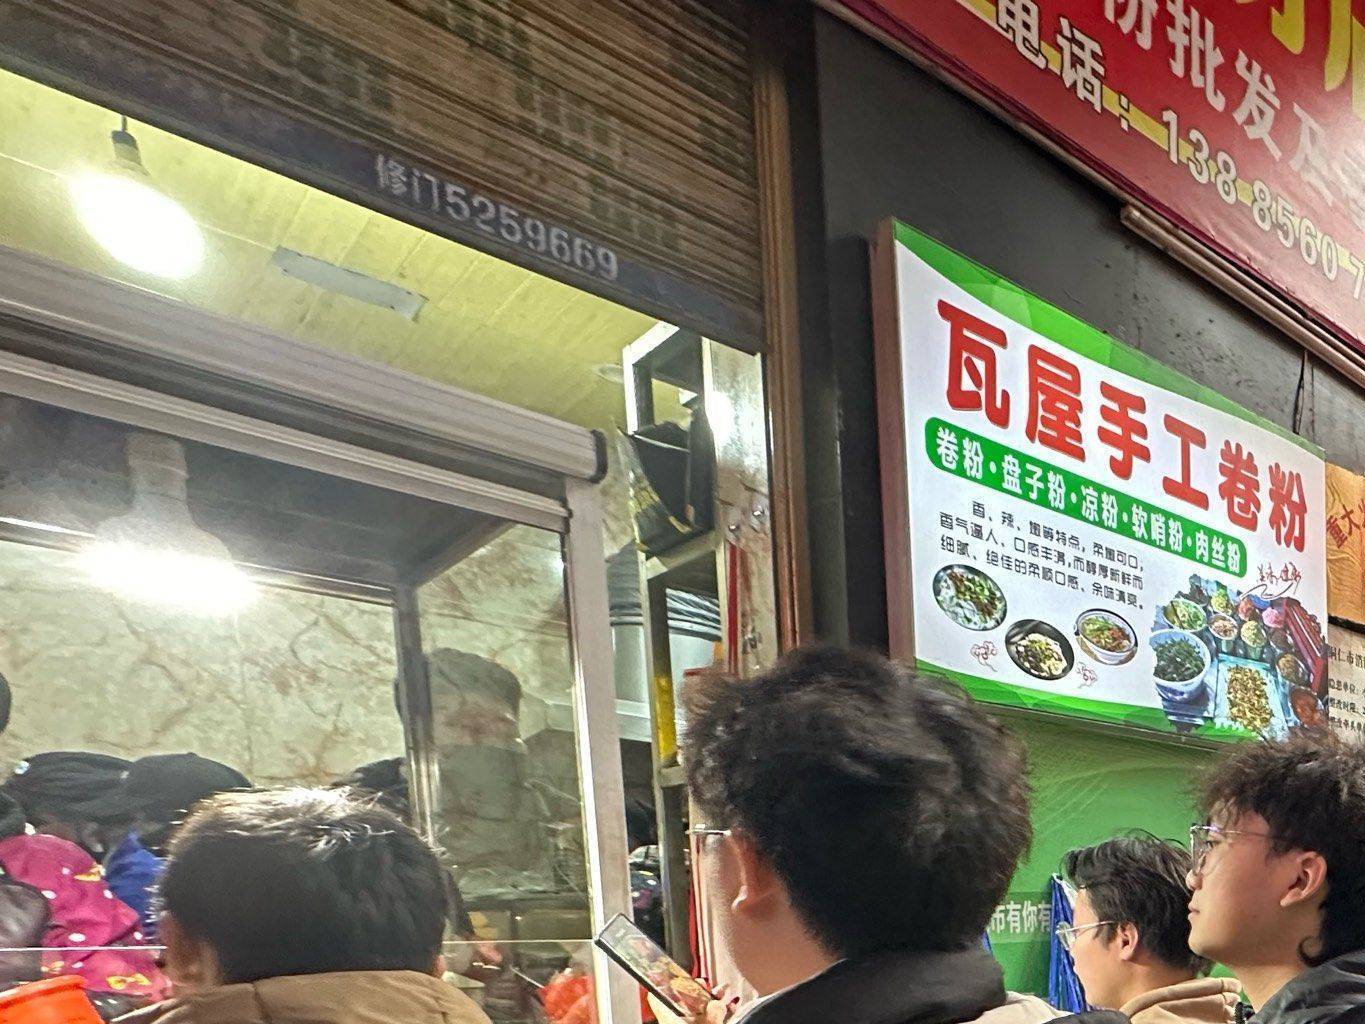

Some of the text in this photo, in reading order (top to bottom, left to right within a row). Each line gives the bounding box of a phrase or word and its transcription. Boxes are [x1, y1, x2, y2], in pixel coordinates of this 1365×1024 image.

[1251, 179, 1339, 282] 8560
[936, 299, 1307, 554] 瓦屋手工卷粉
